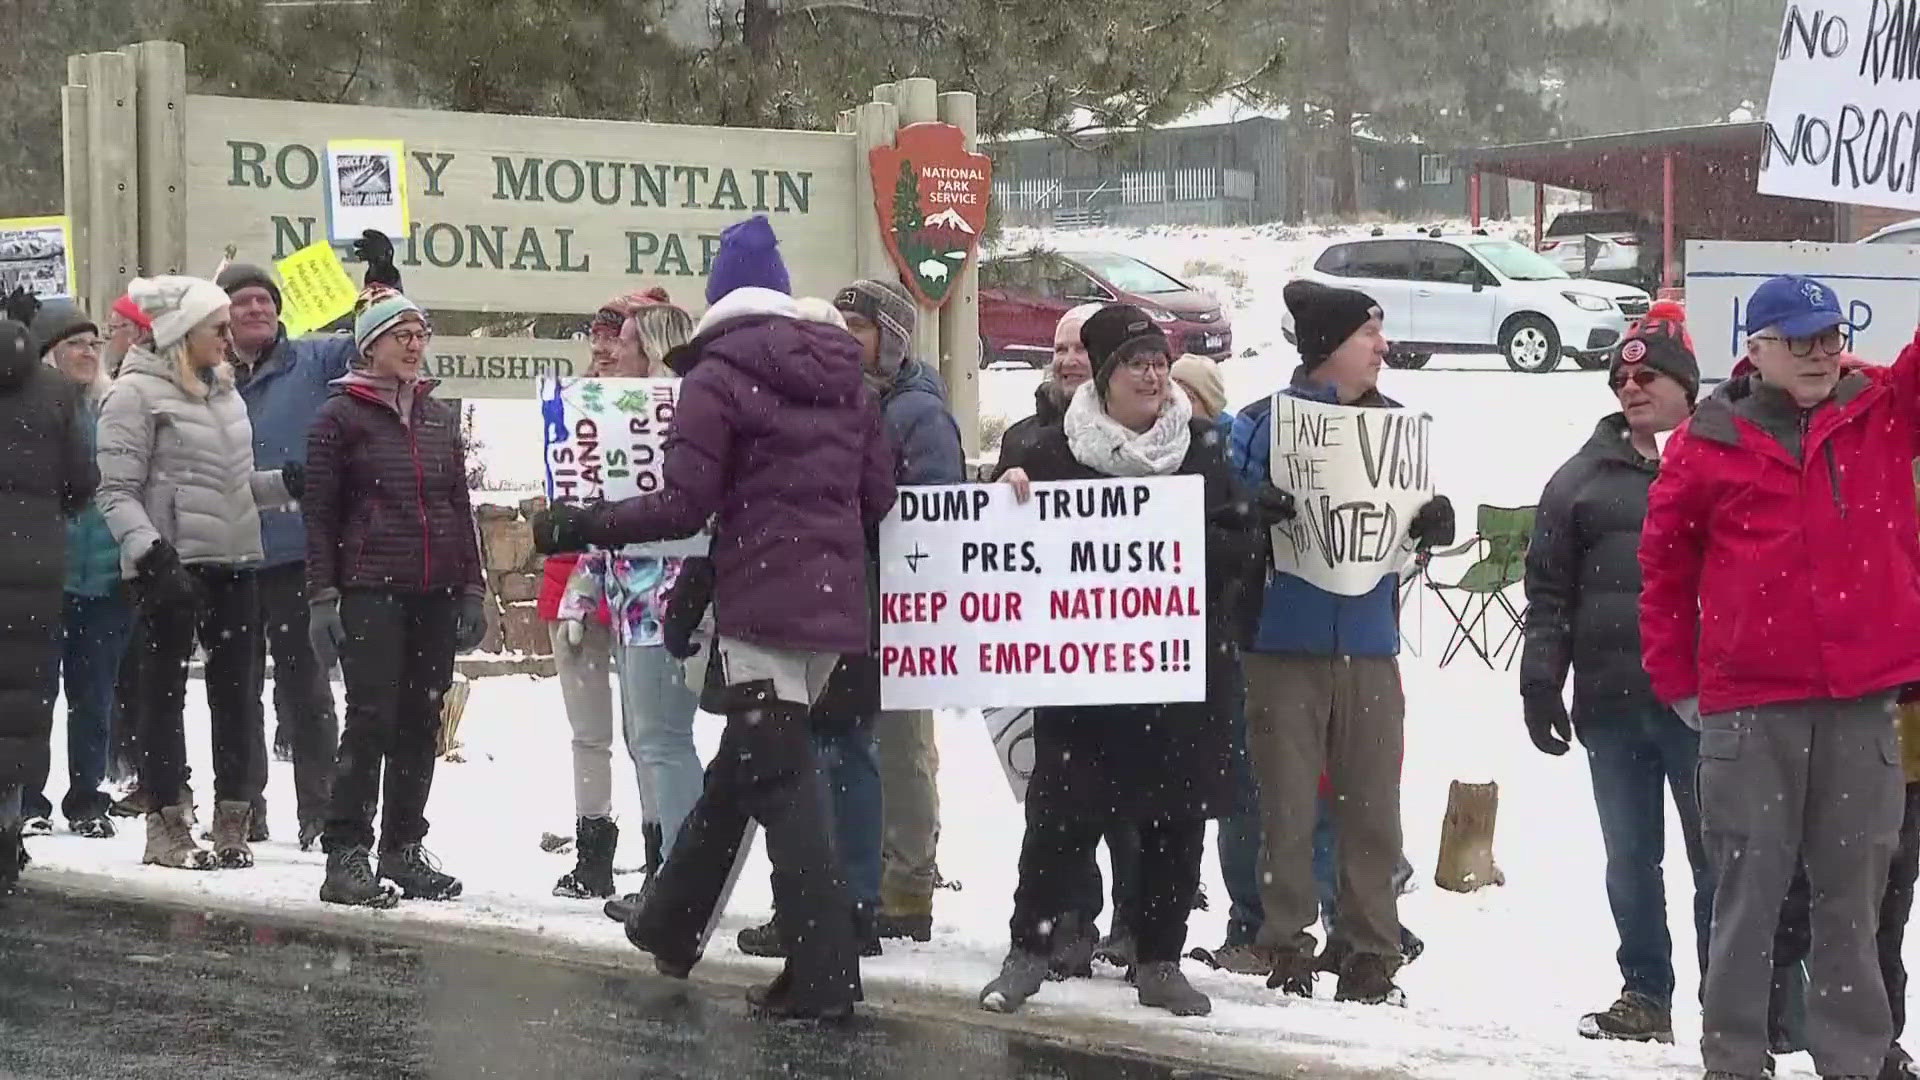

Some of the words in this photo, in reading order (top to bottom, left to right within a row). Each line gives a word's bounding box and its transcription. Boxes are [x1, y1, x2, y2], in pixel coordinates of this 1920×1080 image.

[1779, 4, 1849, 60] NO
[1858, 0, 1920, 86] RAN
[1760, 113, 1831, 172] NO
[226, 140, 455, 197] ROY
[491, 156, 813, 214] MOUNTAIN
[922, 166, 985, 180] NATIONAL
[937, 180, 969, 192] PARK
[929, 191, 977, 205] SERVICE
[271, 215, 590, 273] NIONAL
[1277, 392, 1346, 452] HAVE
[606, 448, 630, 478] IS
[629, 417, 658, 492] OUR
[1282, 453, 1328, 491] THE
[553, 447, 580, 502] HIS
[900, 489, 990, 522] DUMP
[1034, 485, 1151, 521] TRUMP
[961, 541, 1042, 574] PRES.
[1070, 541, 1182, 574] MUSK!
[881, 592, 948, 625] KEEP
[960, 591, 1023, 623] OUR
[1049, 586, 1201, 620] NATIONAL
[881, 644, 959, 678] PARK
[978, 638, 1191, 674] EMPLOYEES!!!
